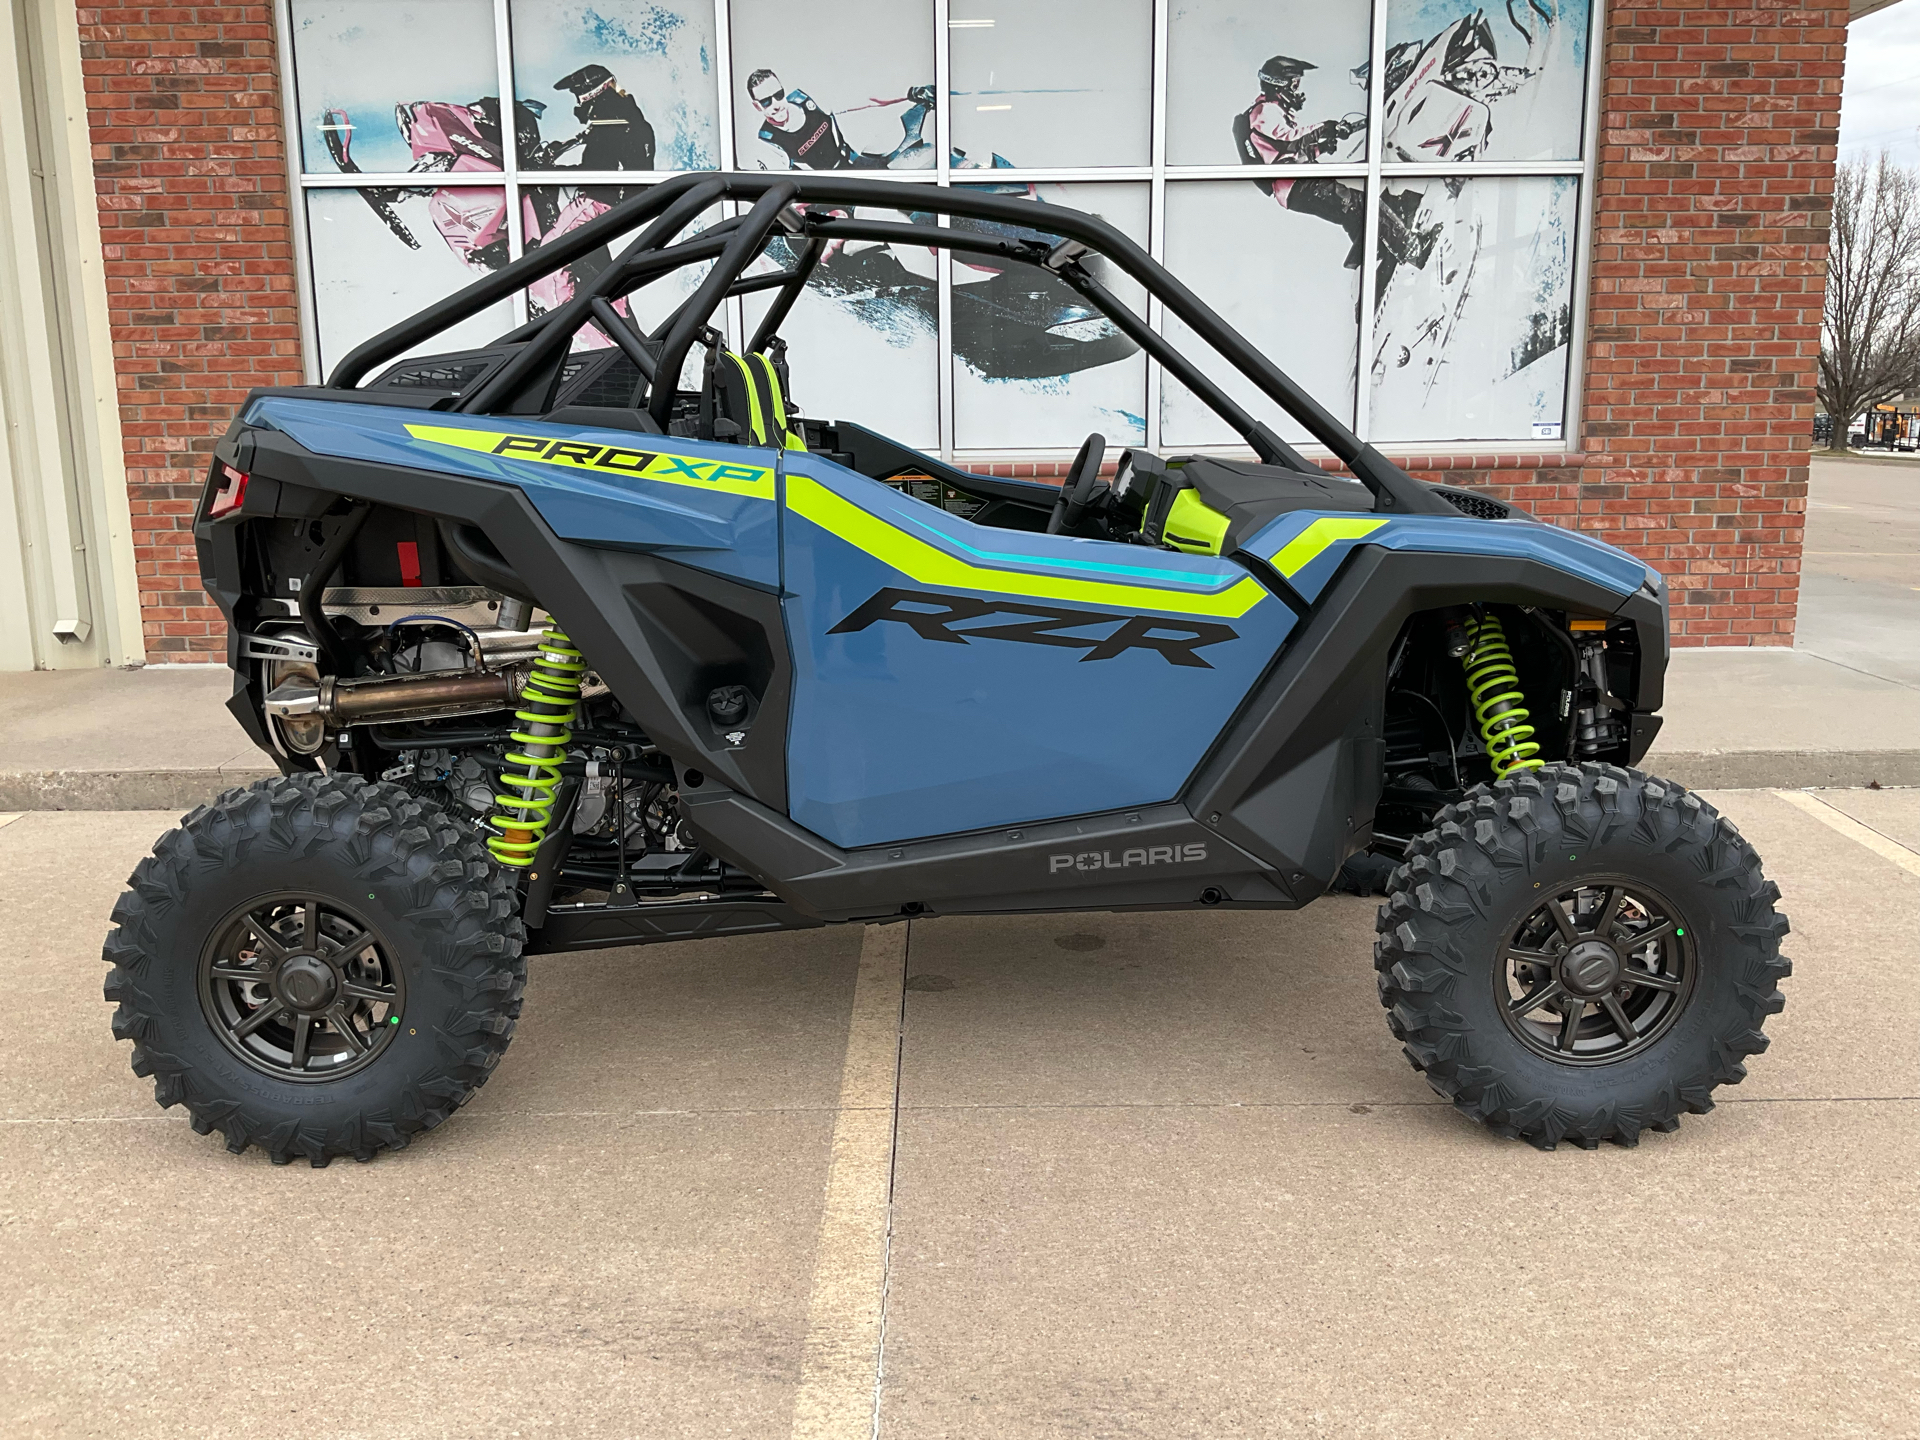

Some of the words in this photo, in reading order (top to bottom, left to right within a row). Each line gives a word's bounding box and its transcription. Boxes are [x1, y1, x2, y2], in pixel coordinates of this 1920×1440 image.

[448, 133, 493, 159] ski-doo
[490, 435, 658, 472] PRO
[652, 456, 766, 483] XP
[825, 586, 1241, 669] RZR
[1049, 841, 1208, 874] POLARIS
[239, 1082, 336, 1106] TERRABOSS
[1593, 1077, 1618, 1089] 2.0
